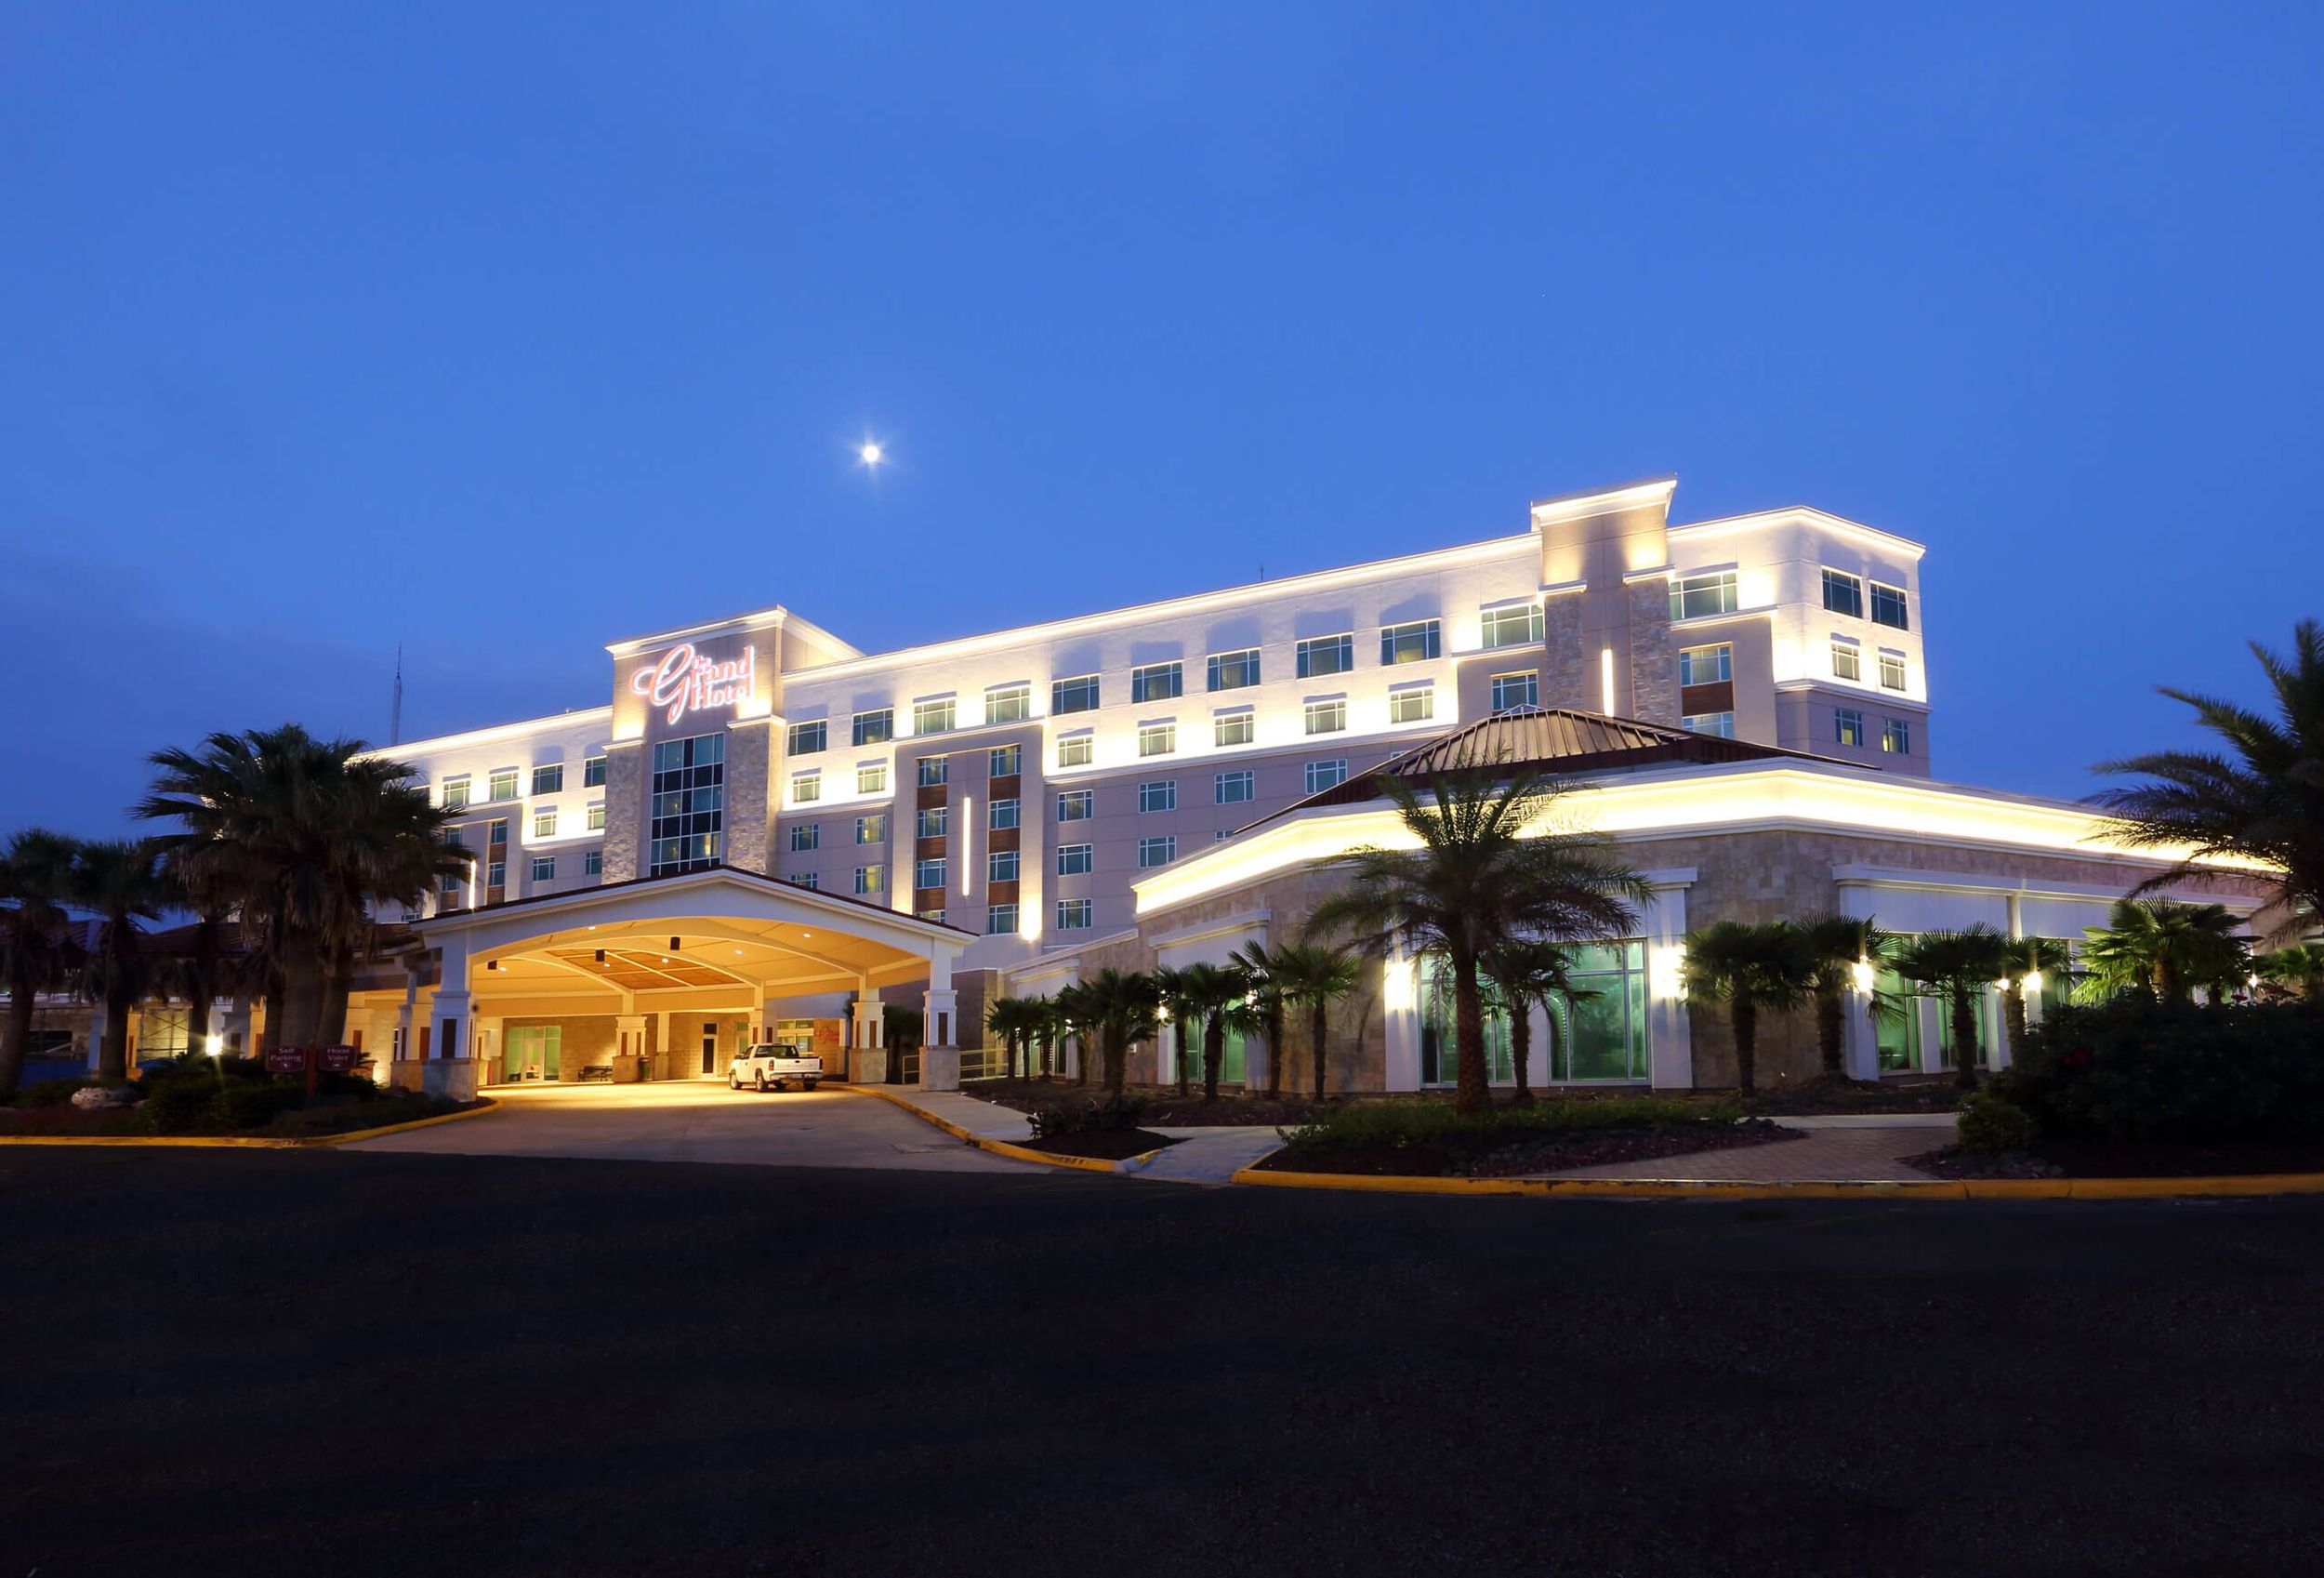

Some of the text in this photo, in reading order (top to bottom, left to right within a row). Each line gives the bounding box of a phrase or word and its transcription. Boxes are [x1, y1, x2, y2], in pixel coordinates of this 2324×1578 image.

[628, 643, 755, 725] Grand
[689, 677, 755, 710] Hotel
[270, 1054, 303, 1063] Parking
